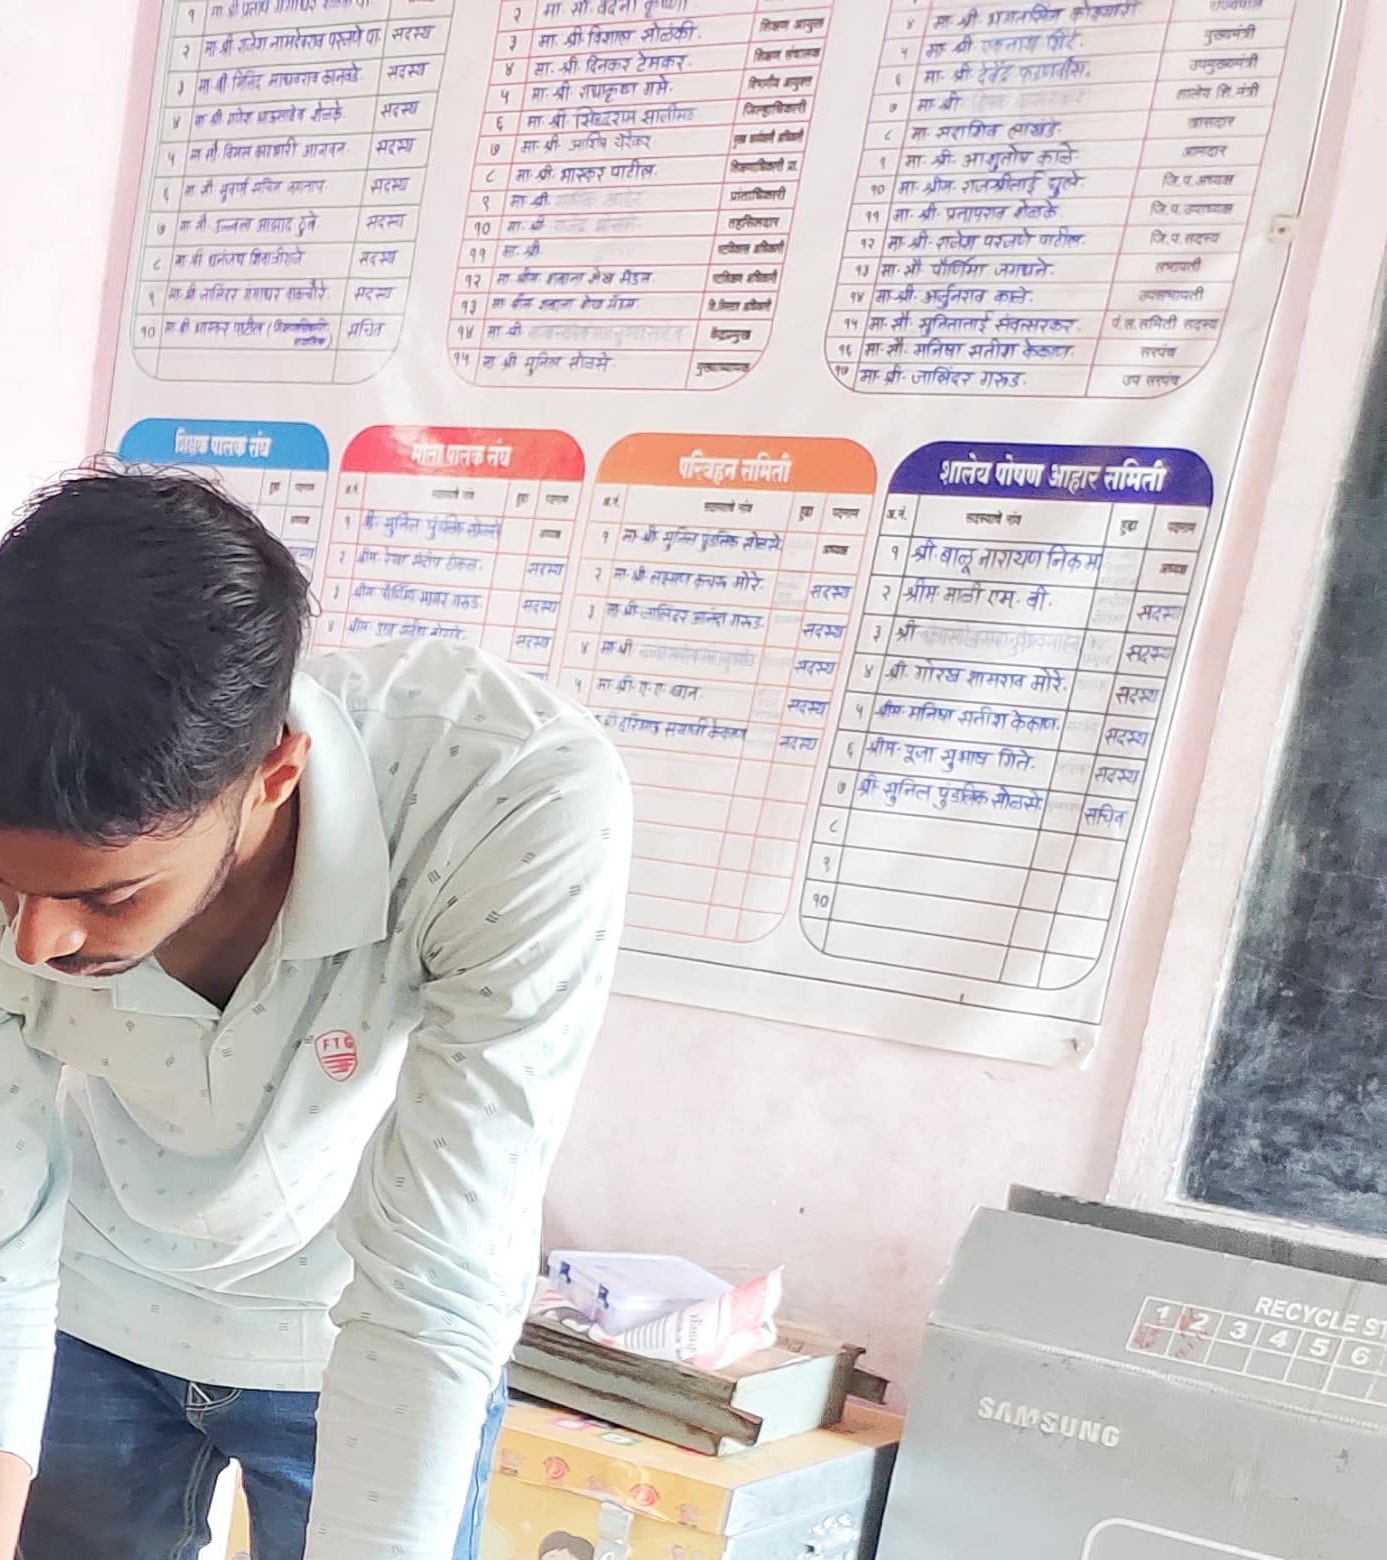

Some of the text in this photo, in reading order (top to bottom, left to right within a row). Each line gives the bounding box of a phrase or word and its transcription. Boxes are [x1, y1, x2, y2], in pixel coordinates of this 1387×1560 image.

[740, 451, 792, 483] समिती
[939, 452, 1167, 493] शालेय पोषण आहार समिती
[1255, 1296, 1359, 1333] RECYCLE
[1156, 1306, 1371, 1365] 1 2 3 4 5 6
[978, 1397, 1120, 1447] SAMSUNG
